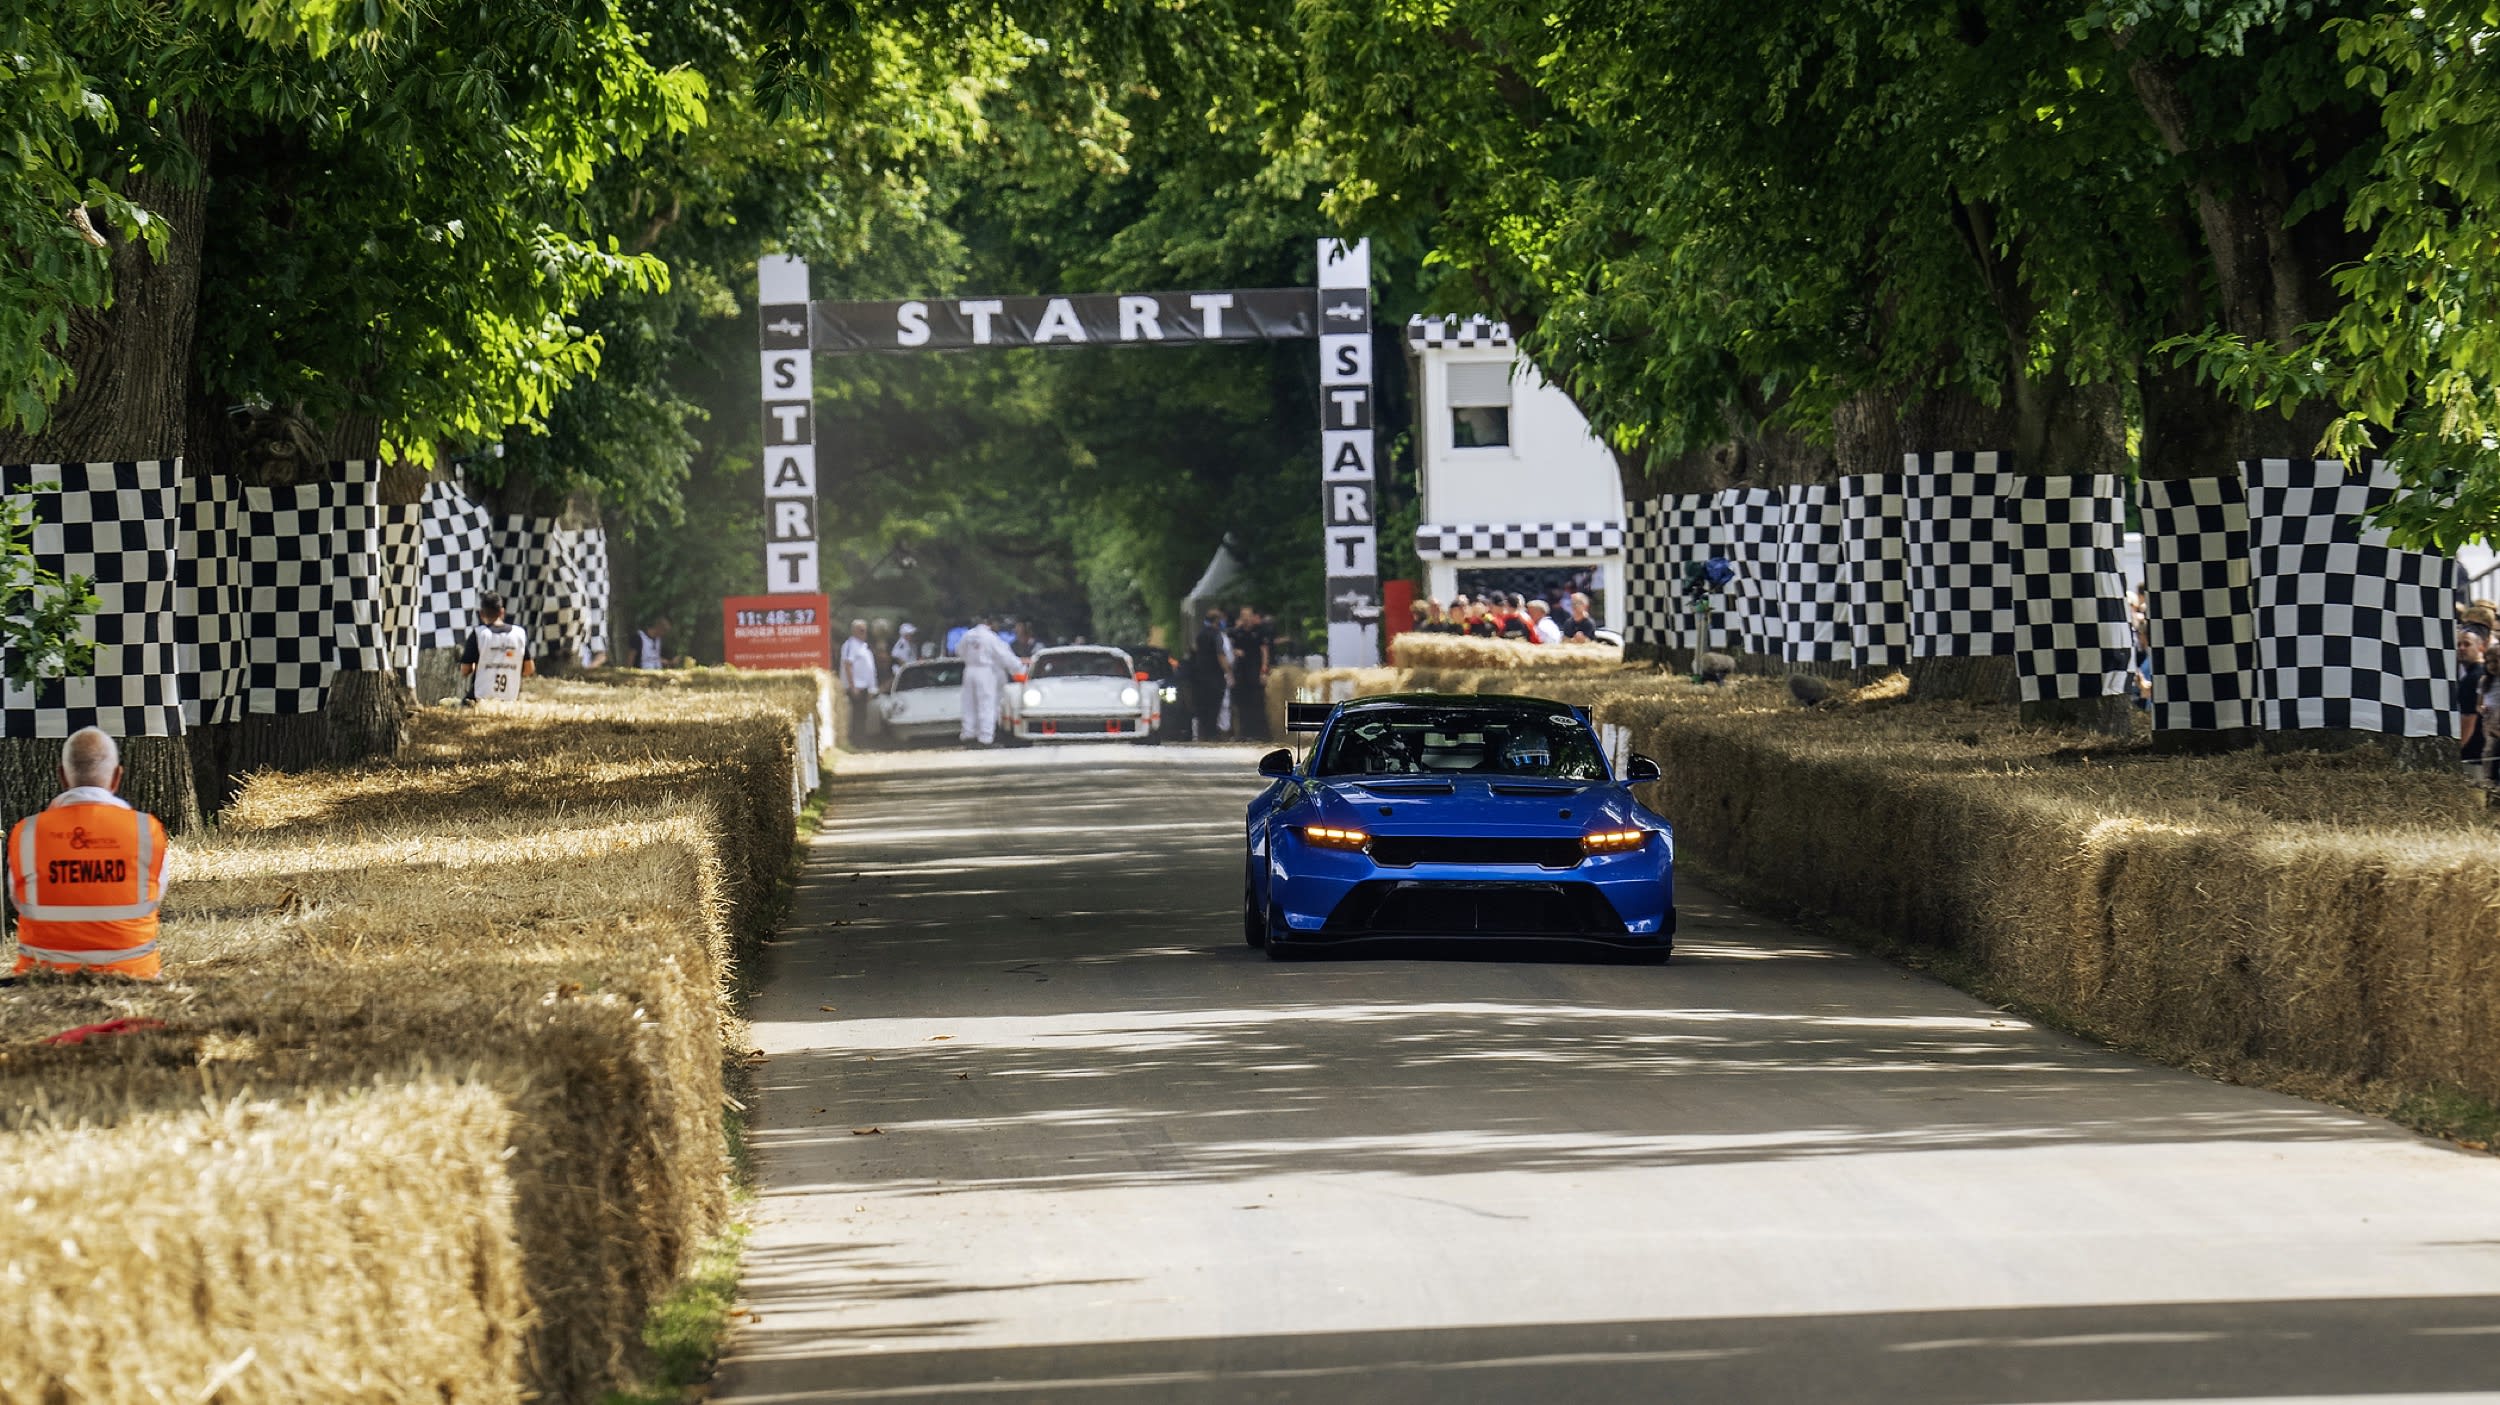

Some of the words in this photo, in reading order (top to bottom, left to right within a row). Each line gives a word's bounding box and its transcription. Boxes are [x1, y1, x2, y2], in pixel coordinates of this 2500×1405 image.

[897, 293, 1234, 346] START
[772, 357, 812, 584] START
[1331, 345, 1370, 568] START
[494, 673, 508, 693] 59
[49, 859, 126, 884] STEWARD
